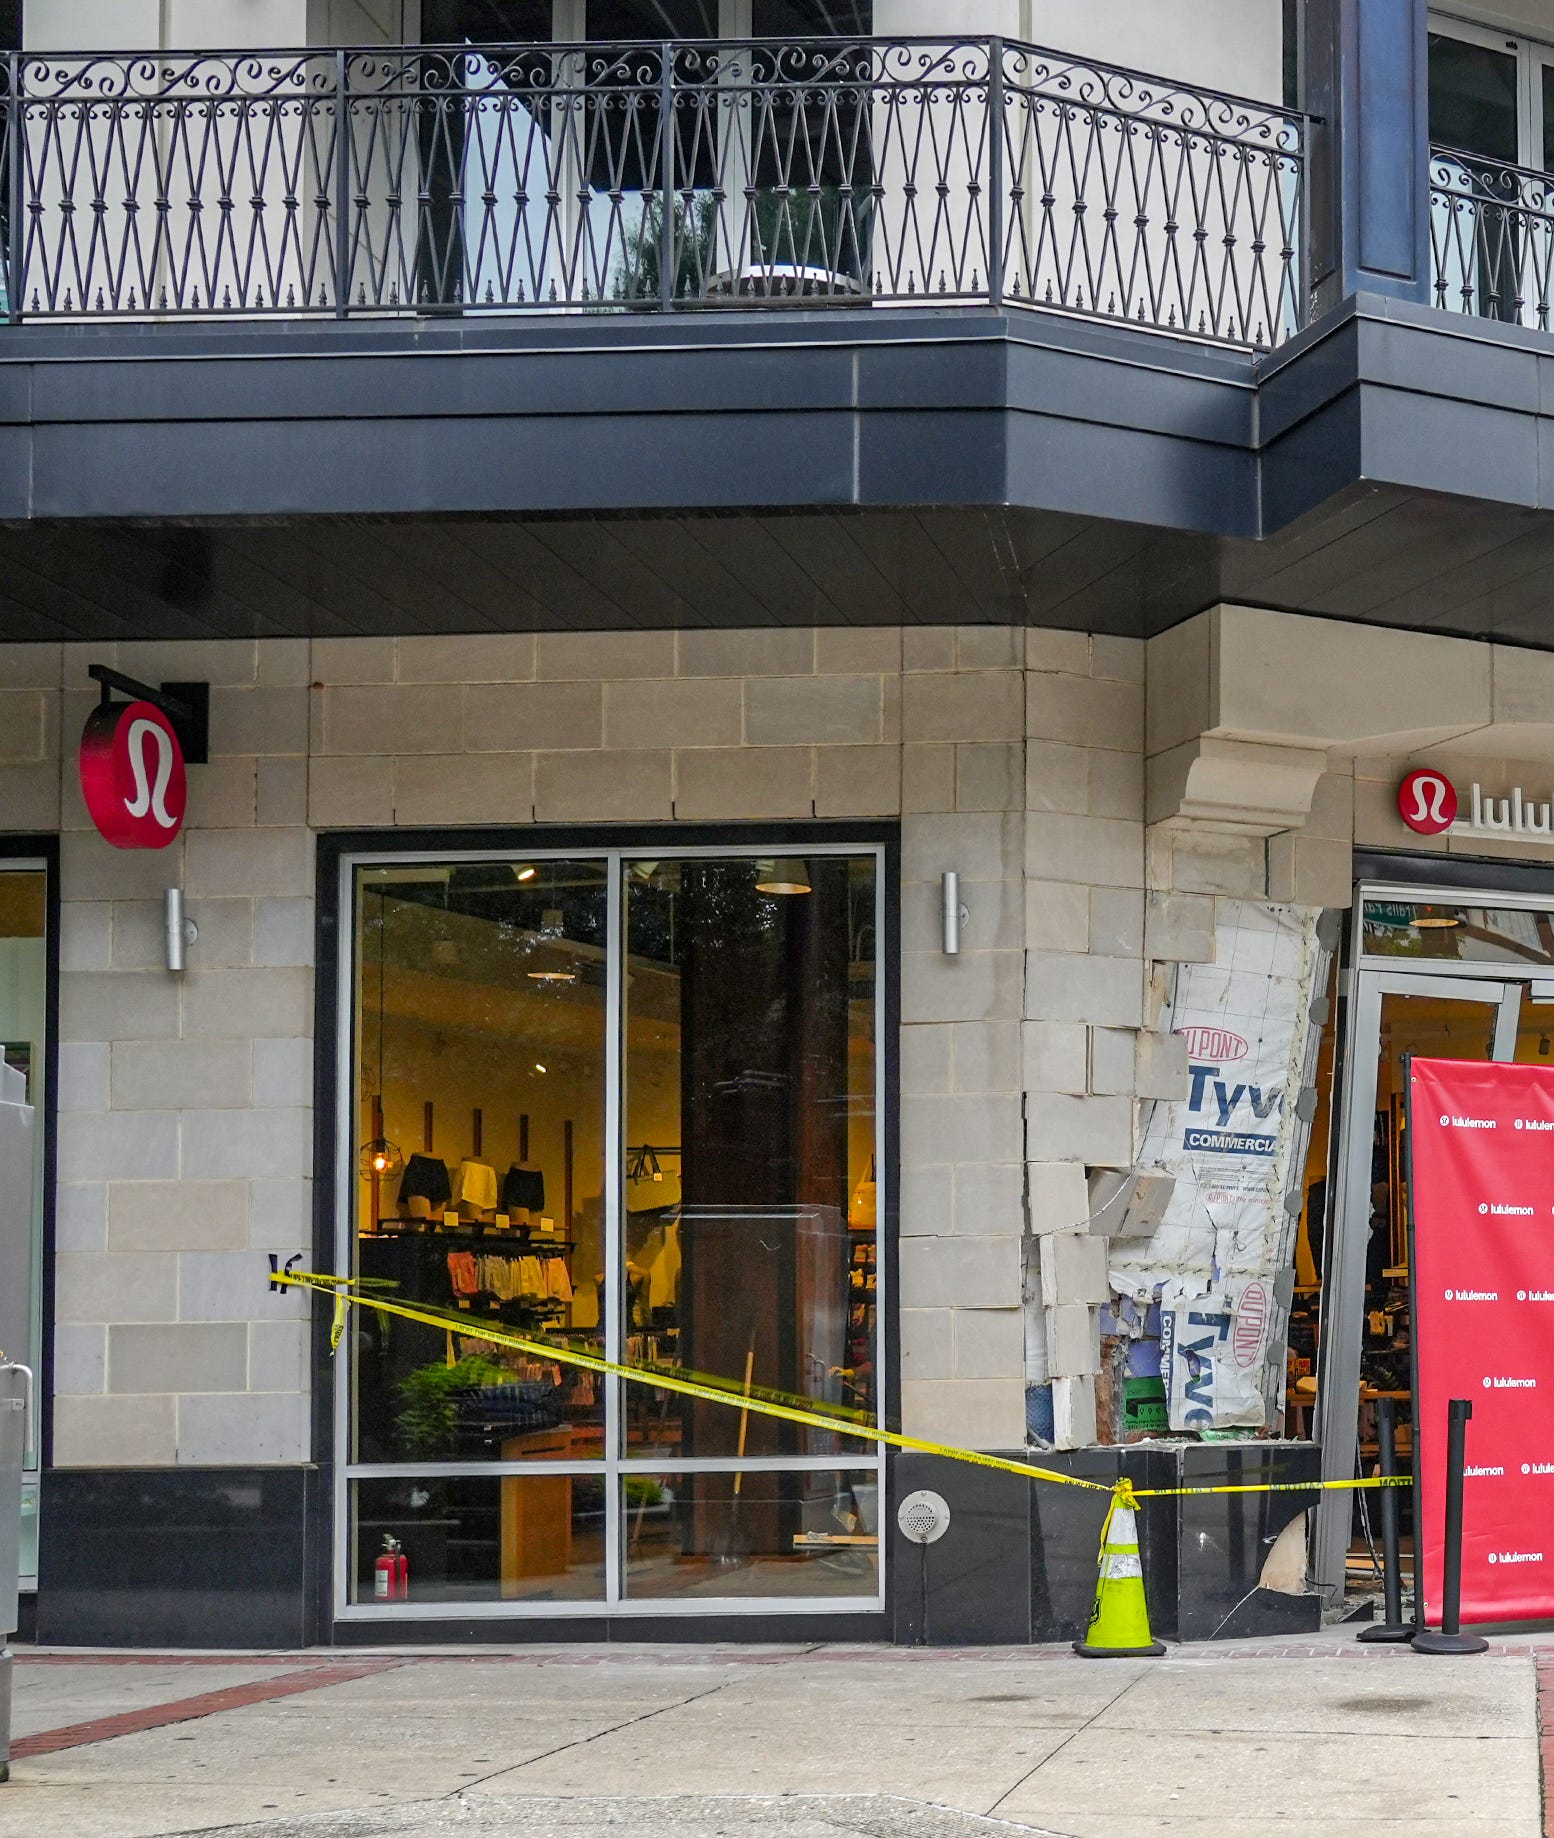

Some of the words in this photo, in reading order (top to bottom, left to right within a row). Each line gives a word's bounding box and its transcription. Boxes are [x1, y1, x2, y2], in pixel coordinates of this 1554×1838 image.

[1451, 1115, 1497, 1129] lululemon
[1490, 1203, 1534, 1216] lululemon
[1455, 1289, 1498, 1301] lululemon
[1493, 1376, 1537, 1388] lululemon
[1463, 1465, 1504, 1477] ululemon
[1498, 1551, 1543, 1564] lululemon
